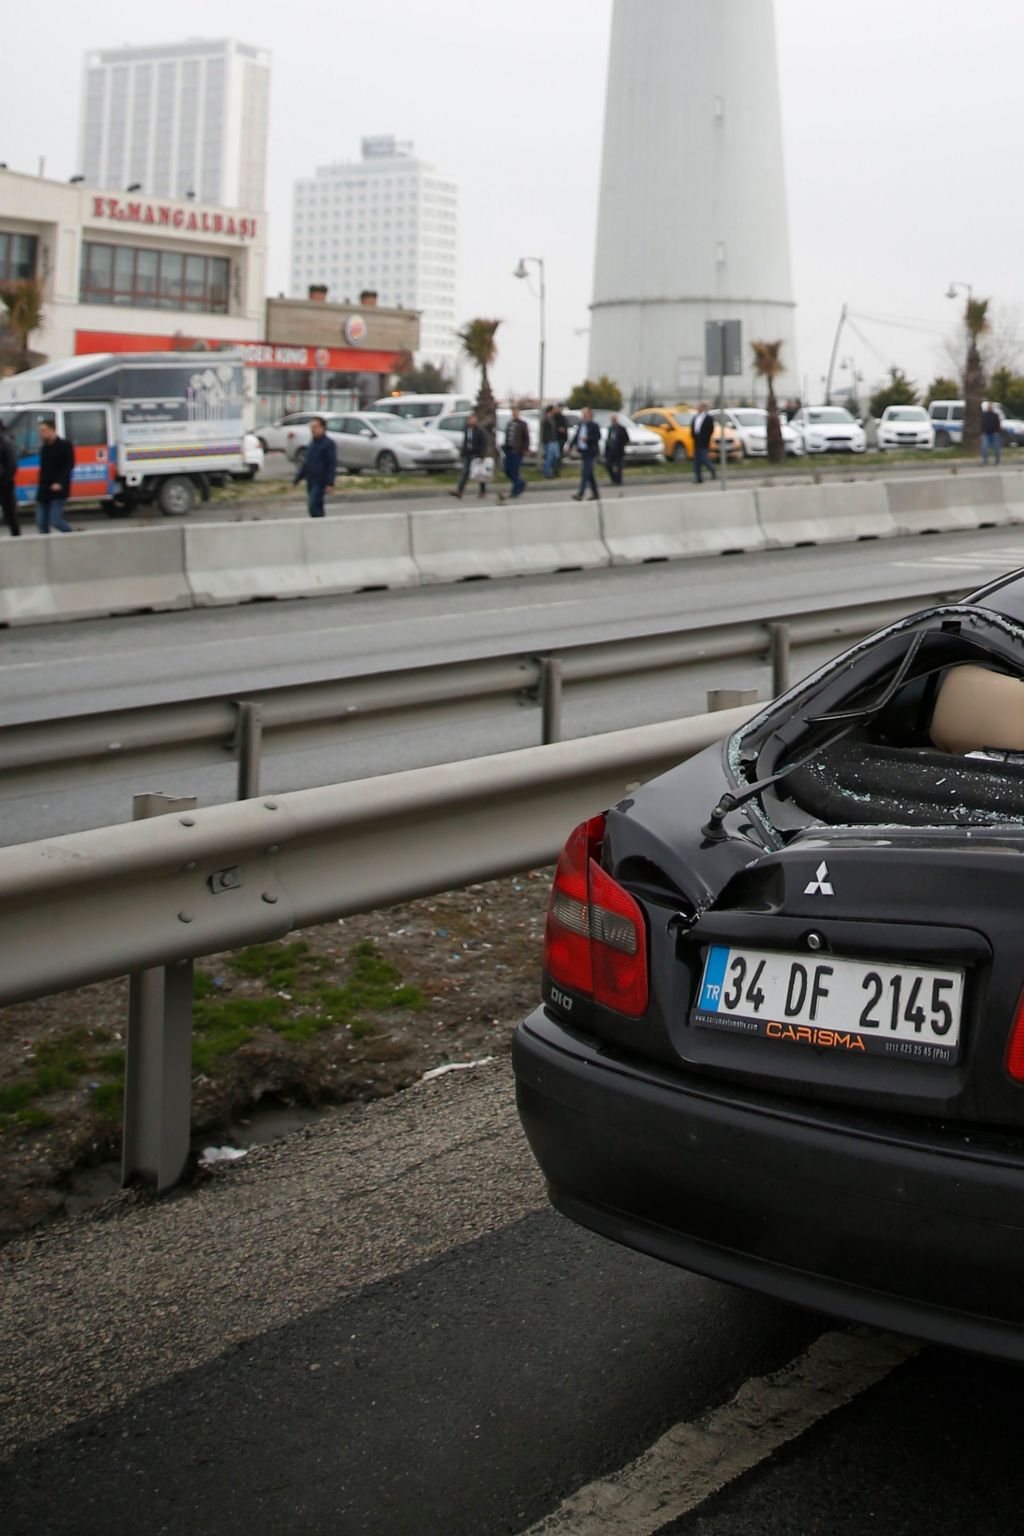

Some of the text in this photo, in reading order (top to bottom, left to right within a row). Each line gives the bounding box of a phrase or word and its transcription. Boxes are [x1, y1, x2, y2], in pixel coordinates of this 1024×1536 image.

[705, 984, 719, 1000] TR
[724, 956, 954, 1036] 34 DF 2145
